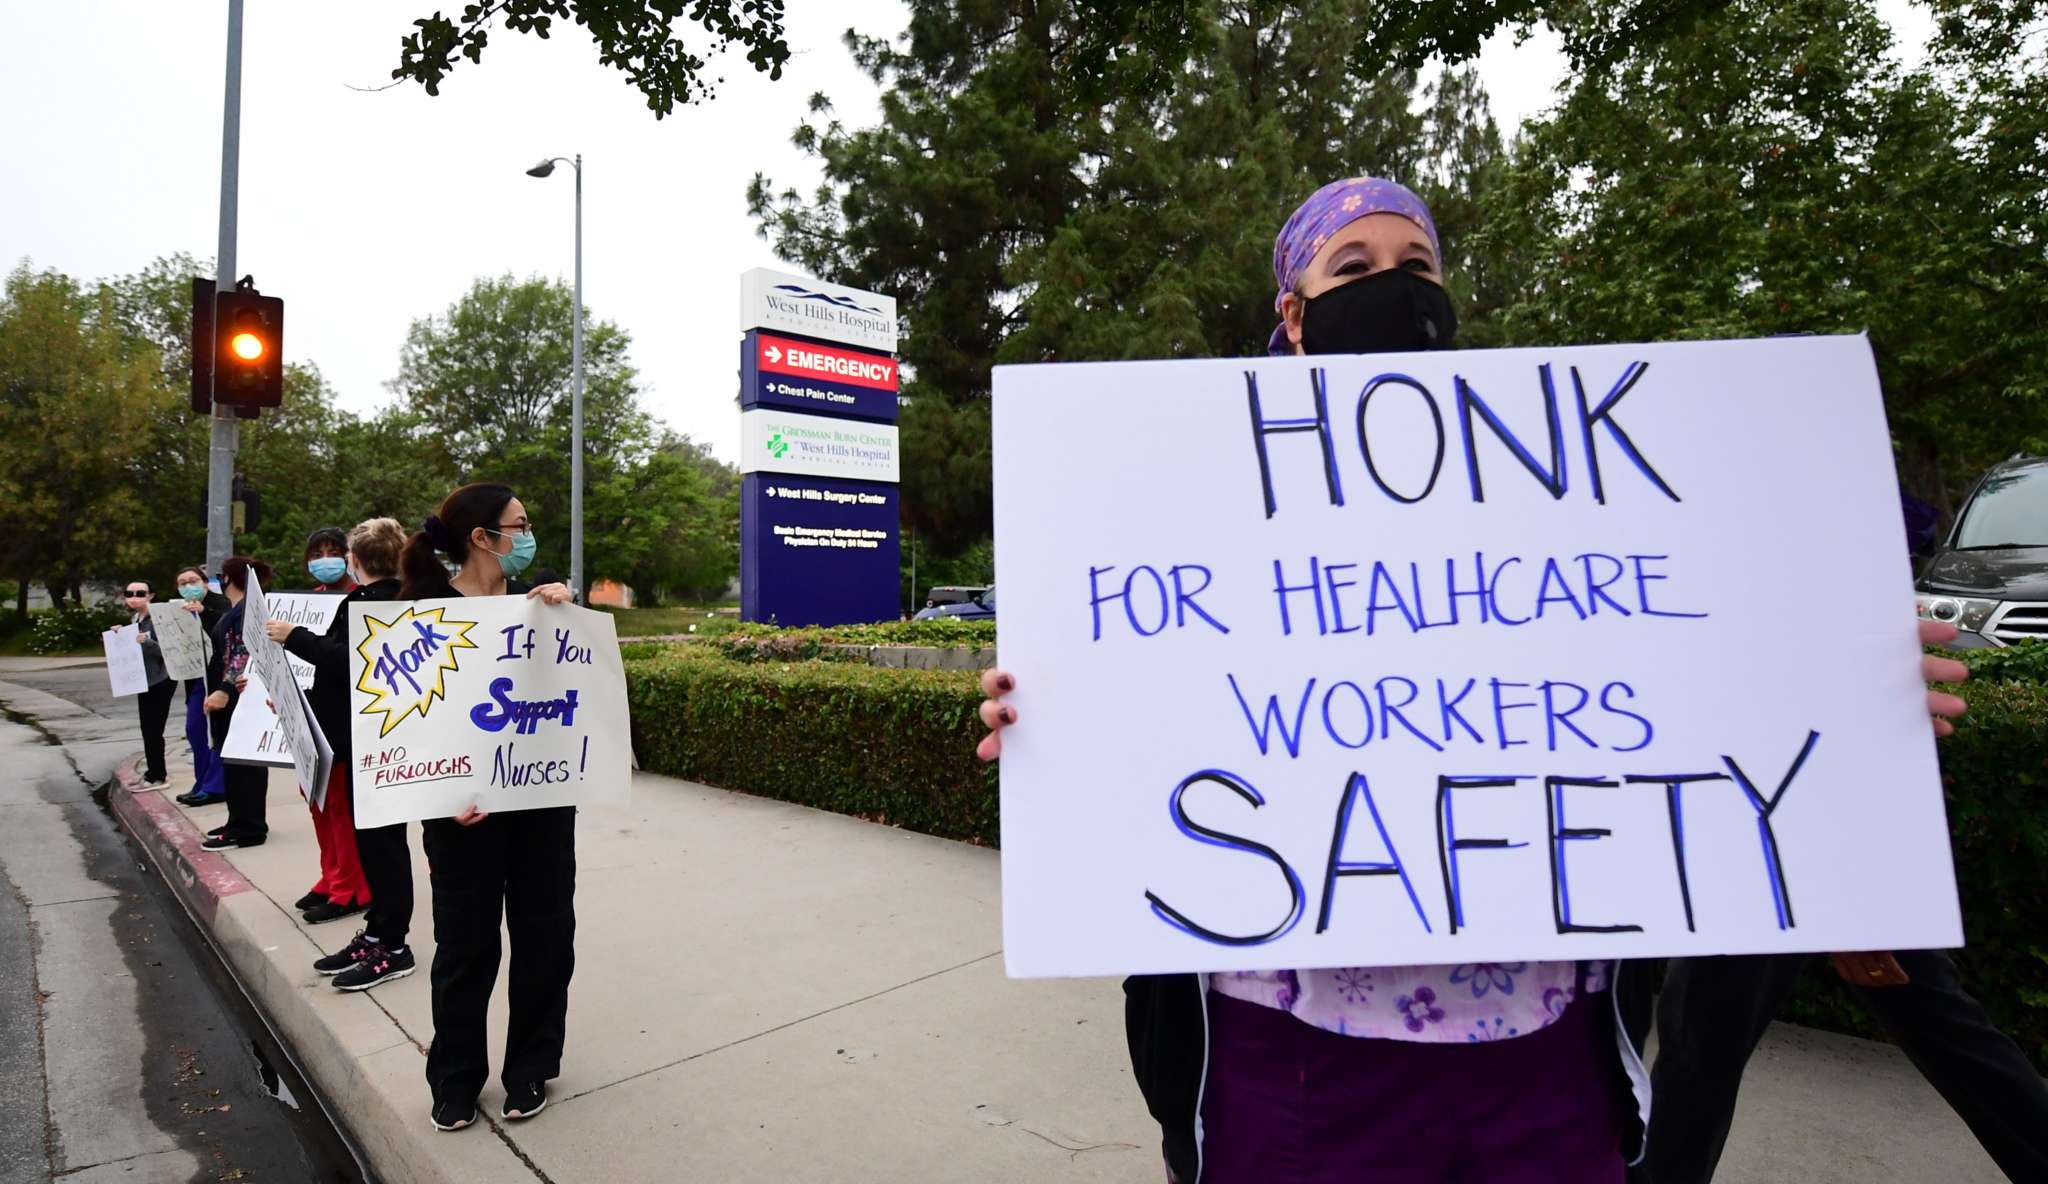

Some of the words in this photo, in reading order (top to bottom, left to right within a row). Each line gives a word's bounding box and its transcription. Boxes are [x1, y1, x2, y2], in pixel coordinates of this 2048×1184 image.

[766, 295, 801, 315] West
[805, 303, 835, 321] Hills
[839, 311, 890, 333] Hospital
[787, 349, 891, 381] EMERGENCY
[777, 384, 804, 398] Chest
[806, 388, 825, 400] Pain
[827, 391, 855, 404] Center
[800, 441, 824, 454] West
[826, 443, 849, 457] Hills
[851, 447, 890, 461] Hospital
[1242, 360, 1682, 519] HONK
[777, 487, 801, 499] West
[802, 489, 822, 500] Hills
[823, 490, 857, 504] Surgery
[858, 493, 886, 504] Center
[267, 598, 325, 625] Violation
[1088, 564, 1230, 642] FOR
[373, 619, 450, 696] Honk
[496, 623, 536, 662] If
[555, 627, 592, 665] You
[469, 677, 579, 735] Support
[1226, 674, 1654, 760] WORKERS
[375, 755, 472, 785] FURLOUGHS
[1144, 729, 1820, 947] SAFETY
